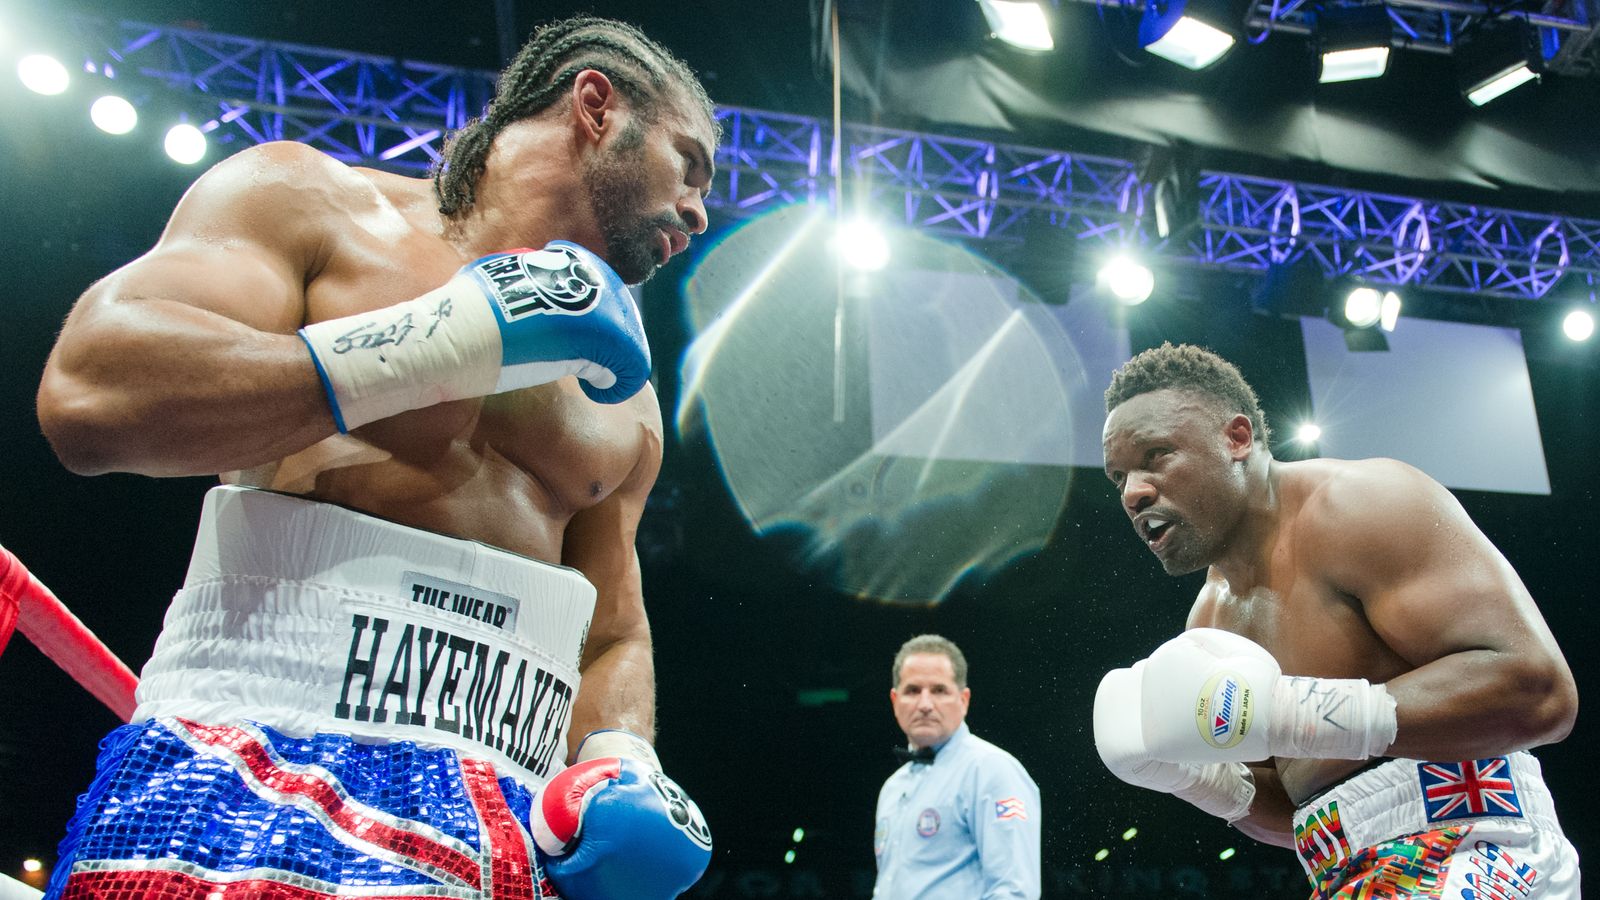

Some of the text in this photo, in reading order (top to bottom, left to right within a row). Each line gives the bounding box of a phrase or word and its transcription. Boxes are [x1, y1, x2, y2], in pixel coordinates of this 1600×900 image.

[481, 255, 554, 317] GRANT
[334, 613, 573, 779] HAYEMAKER
[1214, 679, 1237, 737] Winning
[1239, 718, 1247, 736] Made
[1295, 800, 1352, 888] BOY
